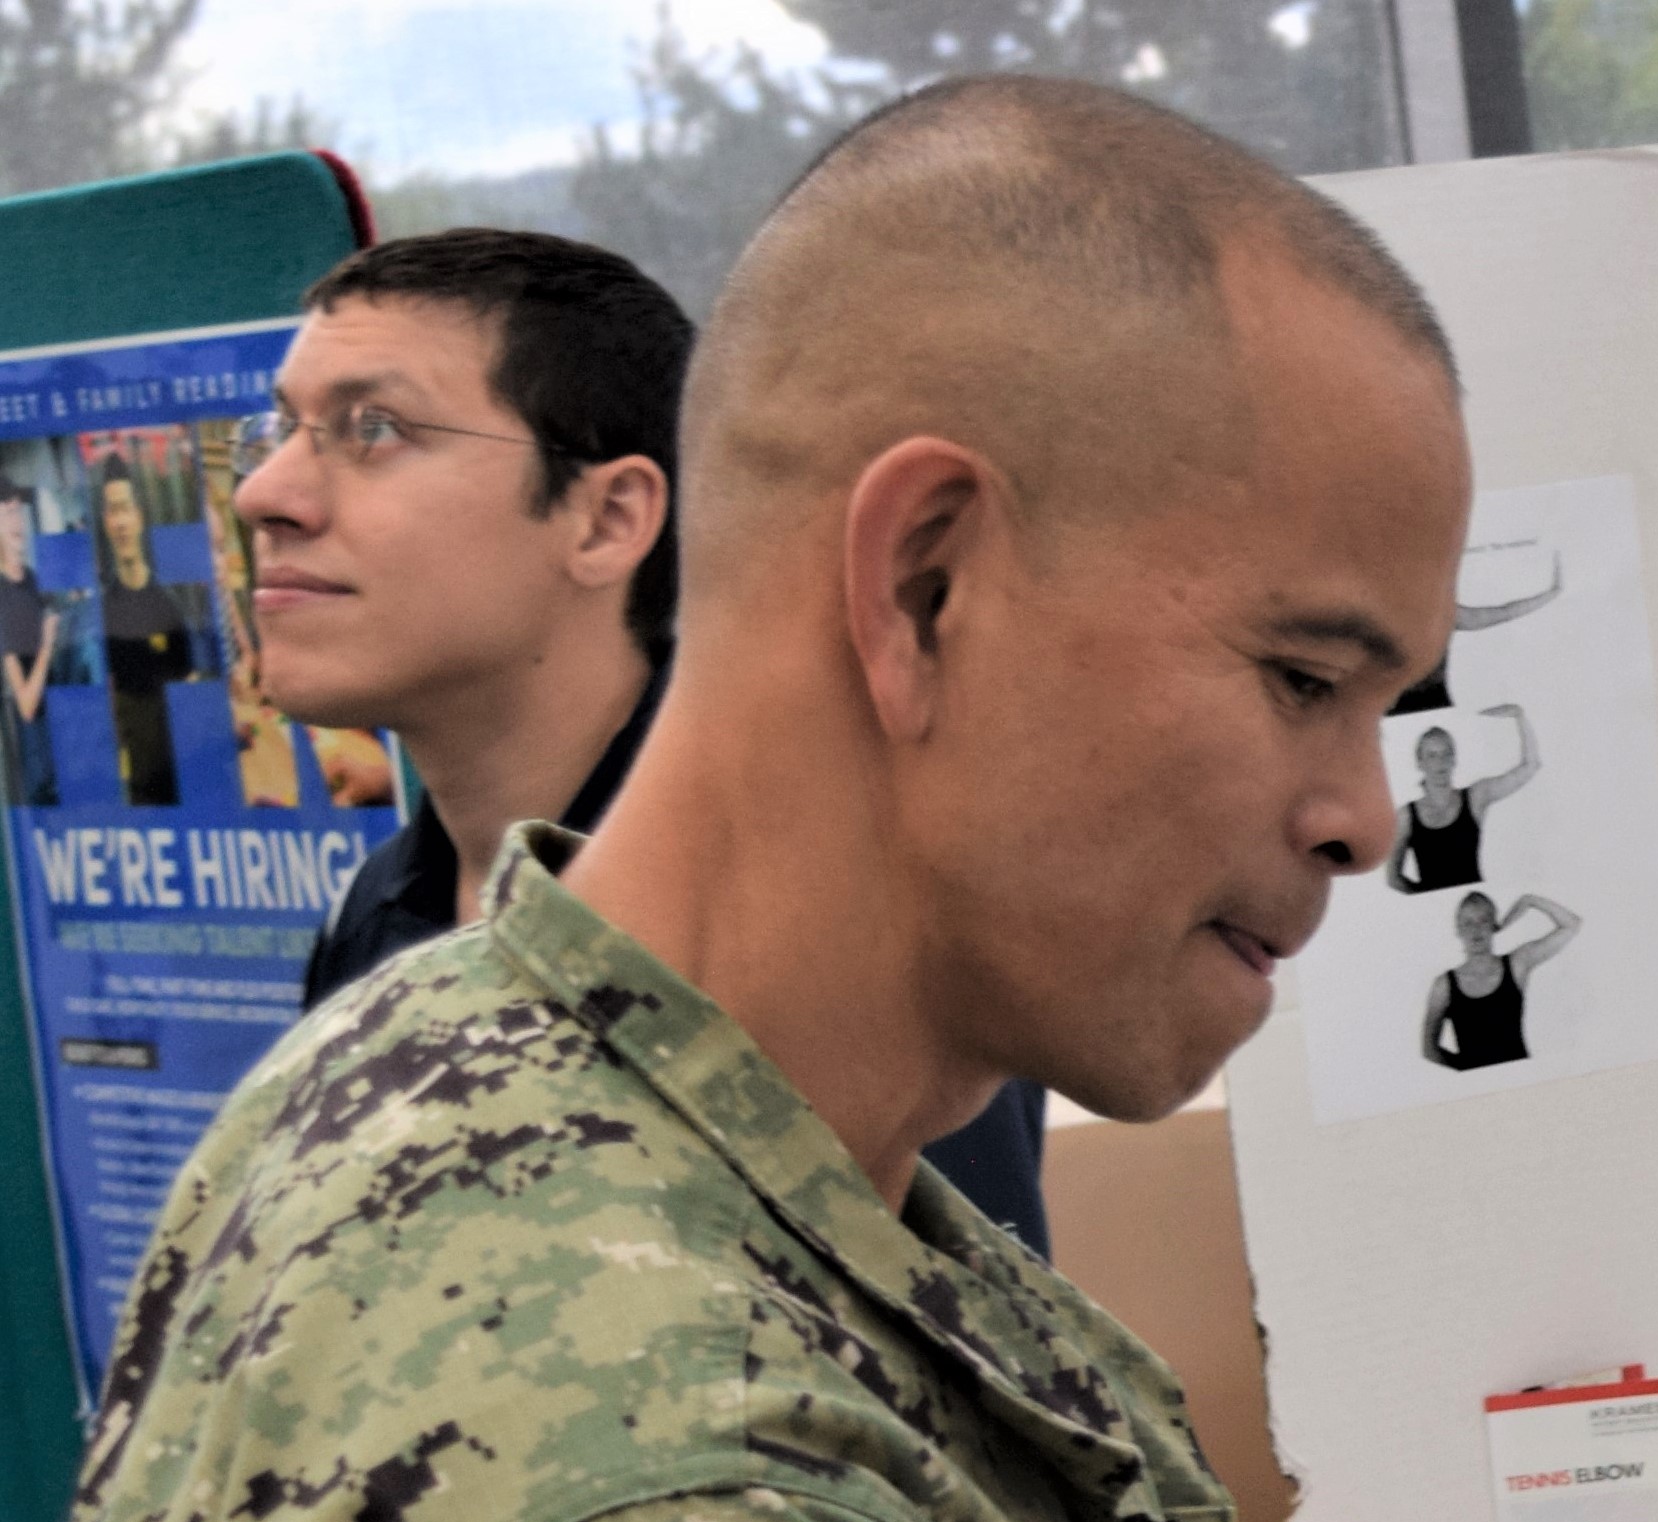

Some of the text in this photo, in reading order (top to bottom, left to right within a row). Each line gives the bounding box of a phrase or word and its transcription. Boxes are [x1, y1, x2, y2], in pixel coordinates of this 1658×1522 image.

[77, 380, 162, 413] FAMILY
[34, 826, 183, 908] WE'RE
[1504, 1461, 1646, 1493] TENNIS ELBOW
